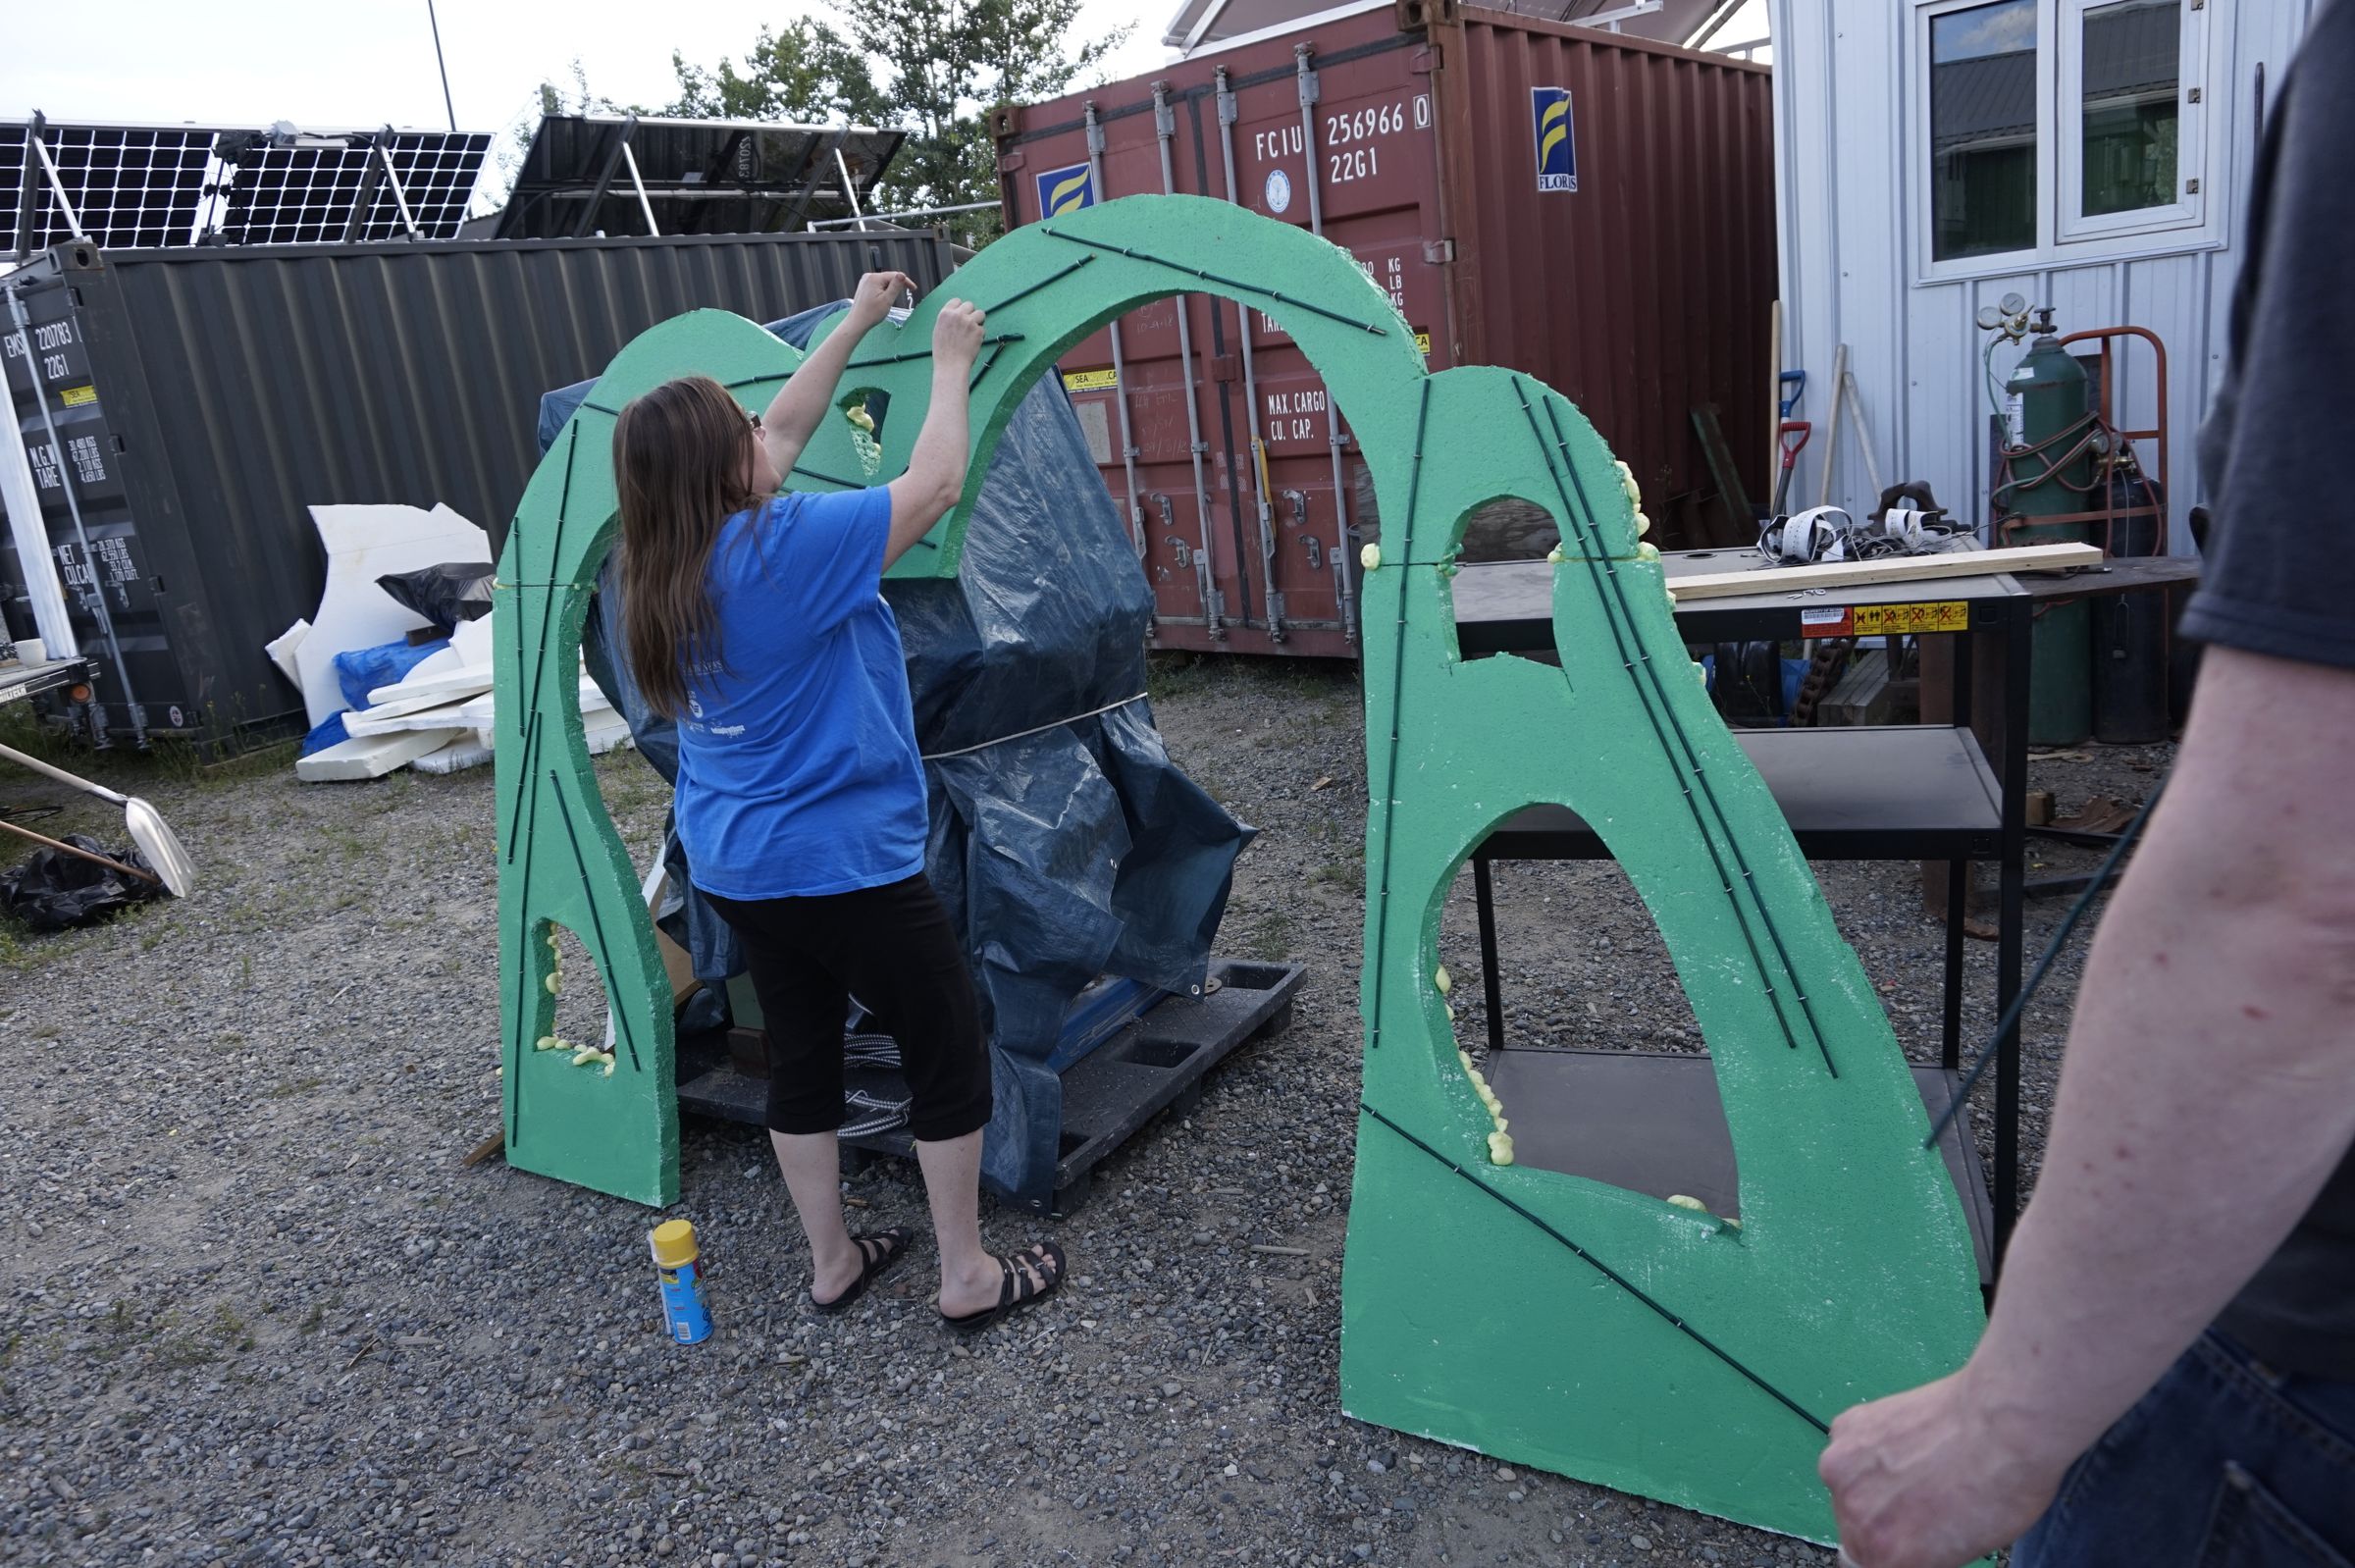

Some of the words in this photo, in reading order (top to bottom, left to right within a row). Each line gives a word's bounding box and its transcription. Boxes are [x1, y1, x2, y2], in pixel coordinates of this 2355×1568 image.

[1255, 125, 1303, 161] FCIU
[1327, 102, 1404, 146] 256966
[1330, 146, 1378, 183] 22G1
[1387, 257, 1401, 274] KG
[1388, 274, 1402, 290] LB
[3, 333, 26, 359] EMS
[34, 321, 73, 351] 220783
[43, 353, 70, 381] 22G1
[1268, 392, 1292, 415] MAX.
[1294, 391, 1326, 413] CARGO
[1271, 420, 1286, 441] CU.
[1292, 418, 1314, 440] CAP.
[35, 465, 61, 489] TARE
[57, 544, 76, 565] NET
